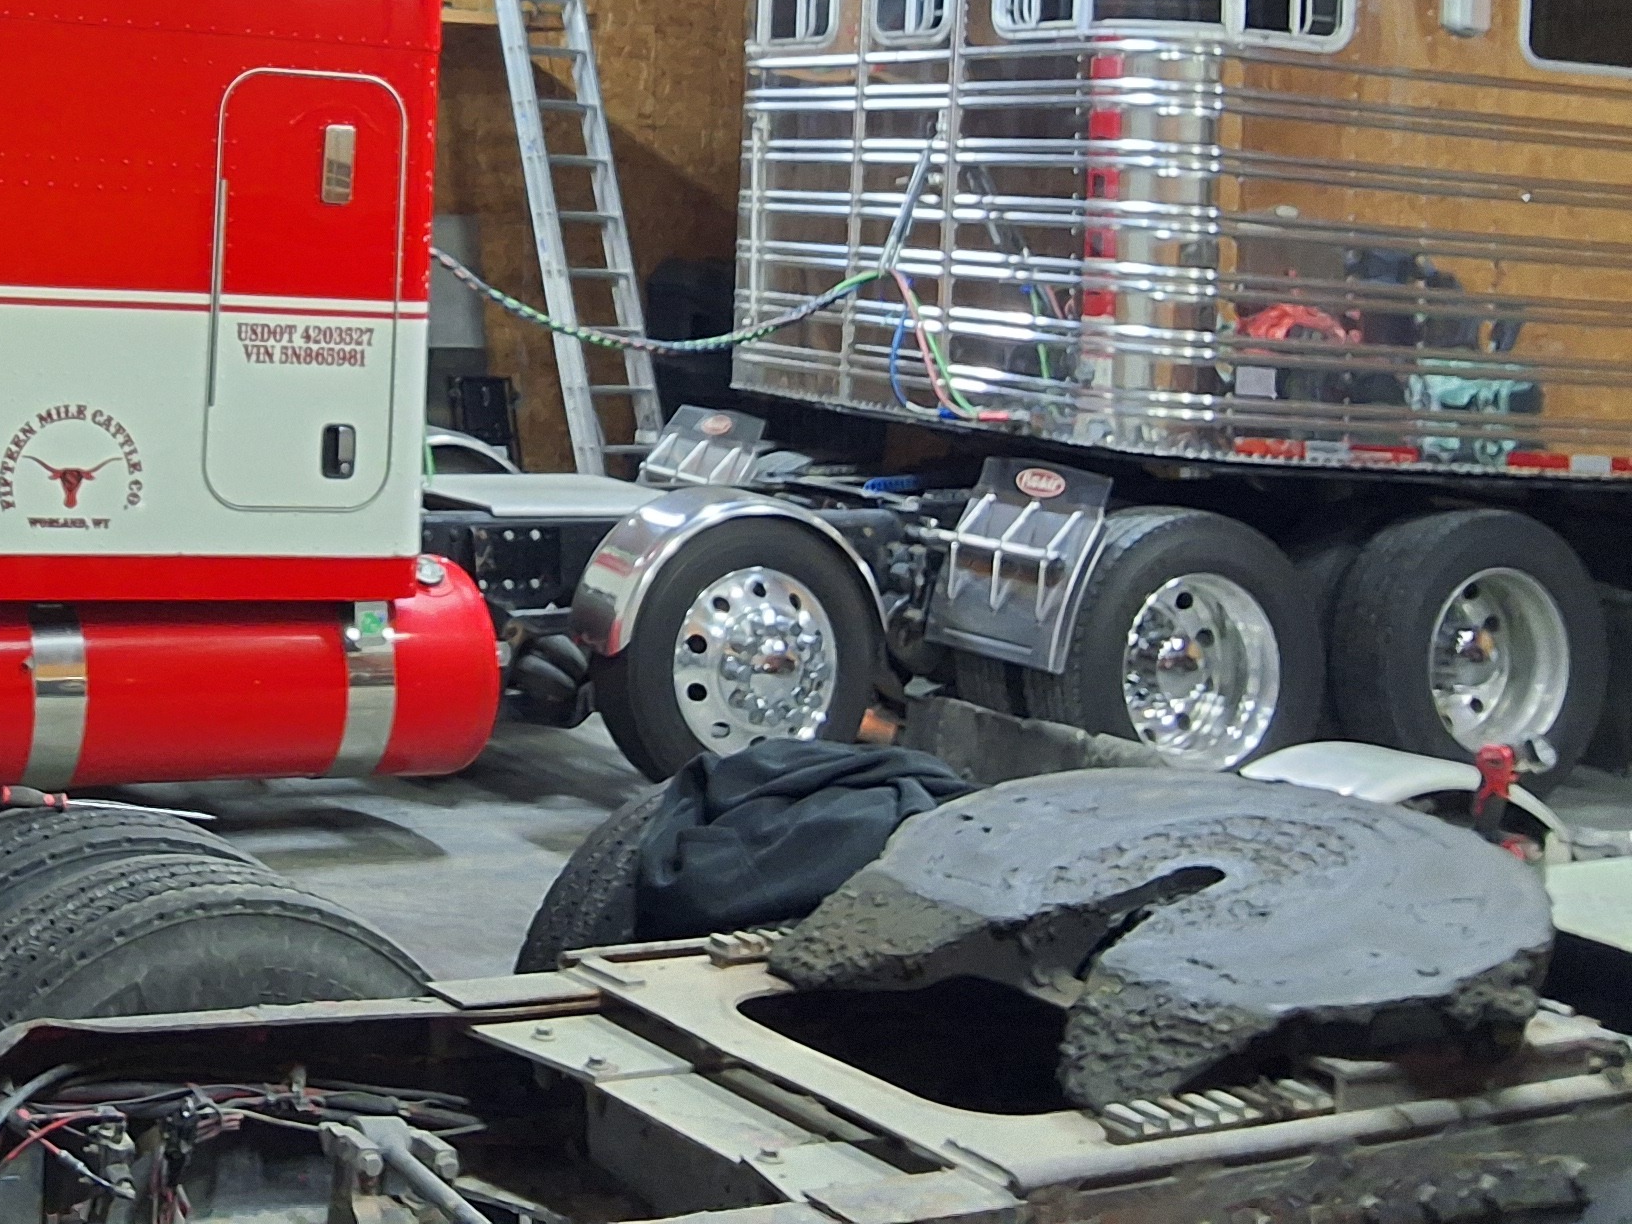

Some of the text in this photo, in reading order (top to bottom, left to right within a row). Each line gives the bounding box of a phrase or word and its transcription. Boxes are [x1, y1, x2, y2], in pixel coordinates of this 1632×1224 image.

[237, 322, 375, 347] USDOT 4203527
[243, 344, 366, 367] VIN 5N865981
[36, 404, 88, 429] MILE
[91, 409, 143, 475] CATTLE
[123, 479, 143, 510] CO.
